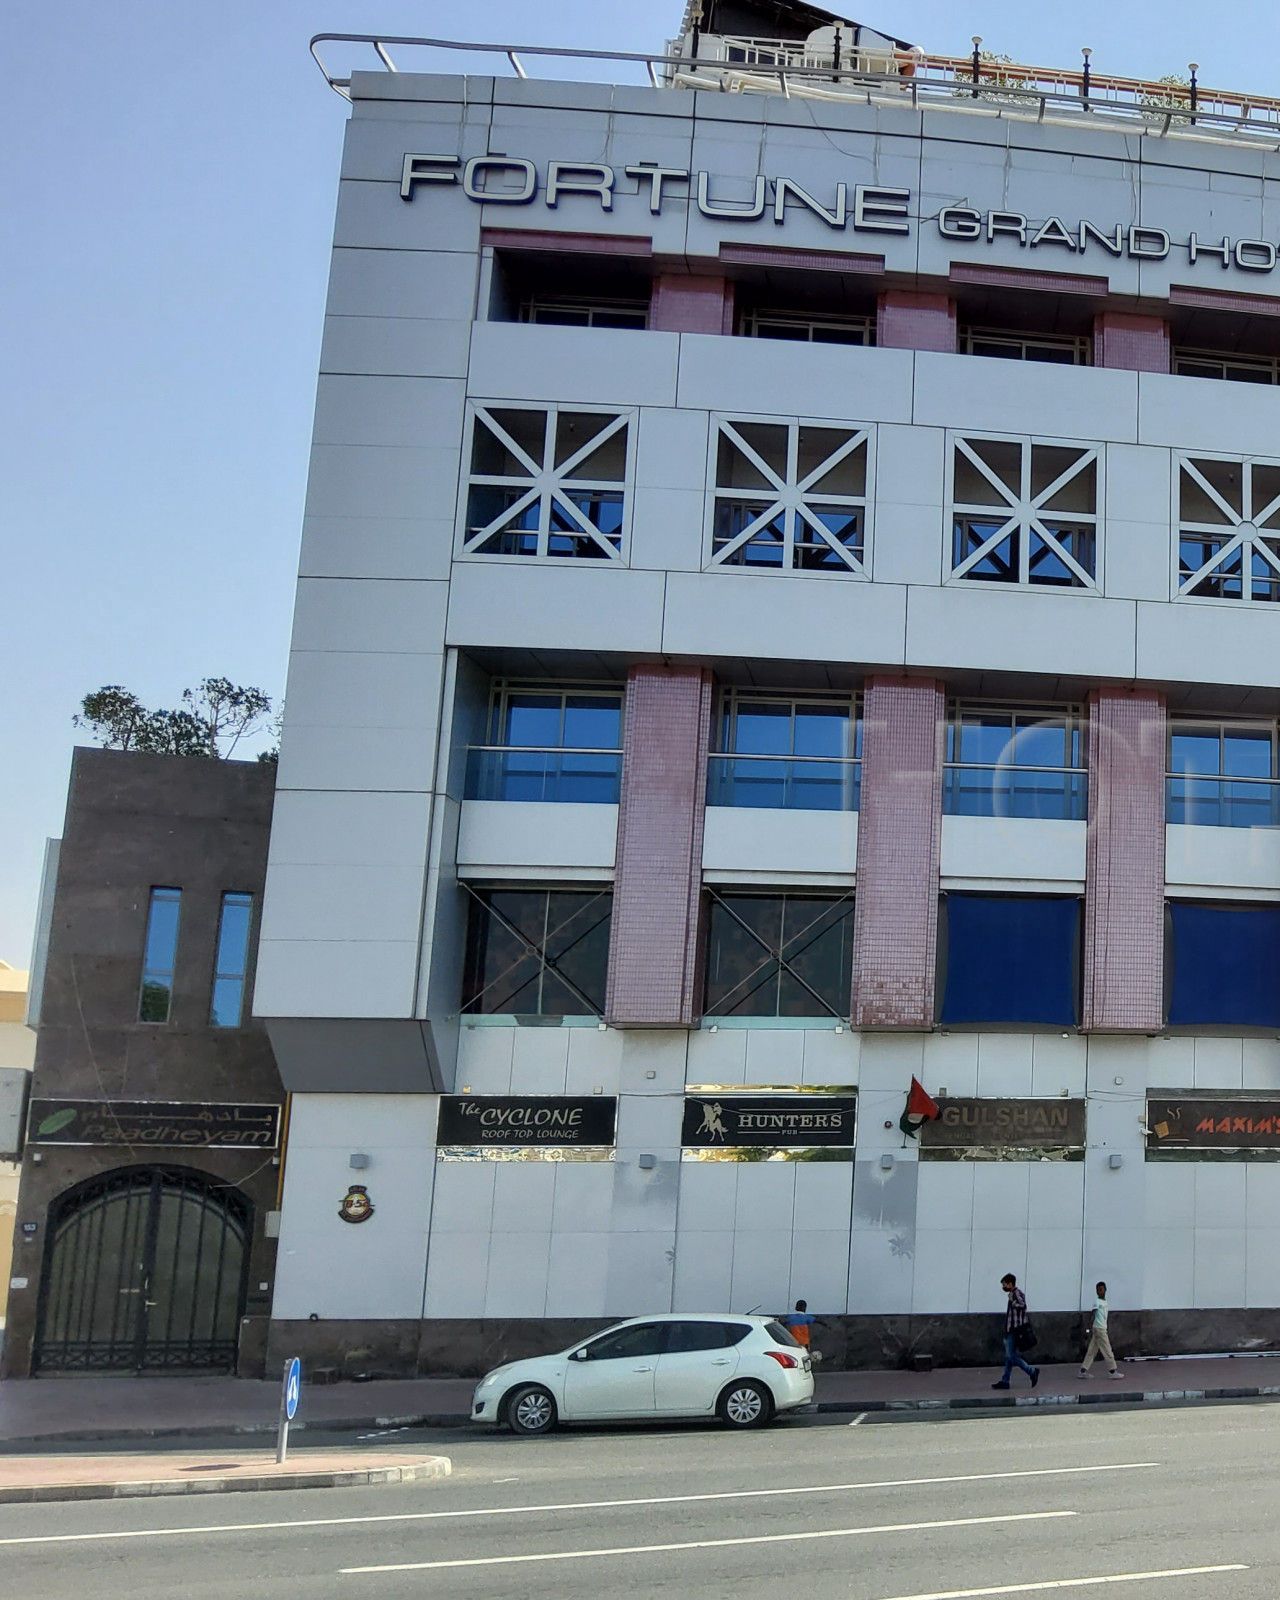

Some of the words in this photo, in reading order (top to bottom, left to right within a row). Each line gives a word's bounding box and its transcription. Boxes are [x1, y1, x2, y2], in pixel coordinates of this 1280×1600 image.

[400, 152, 911, 238] FORTUNE
[938, 205, 1170, 261] GRAND
[459, 1101, 481, 1116] The
[480, 1107, 583, 1126] CYCLONE
[738, 1113, 842, 1128] HUNTERS
[942, 1106, 1068, 1127] GULSHAN
[82, 1125, 271, 1144] Paadheyam
[482, 1129, 511, 1138] ROOF
[513, 1129, 534, 1139] TOP
[537, 1129, 579, 1139] LOUNGE
